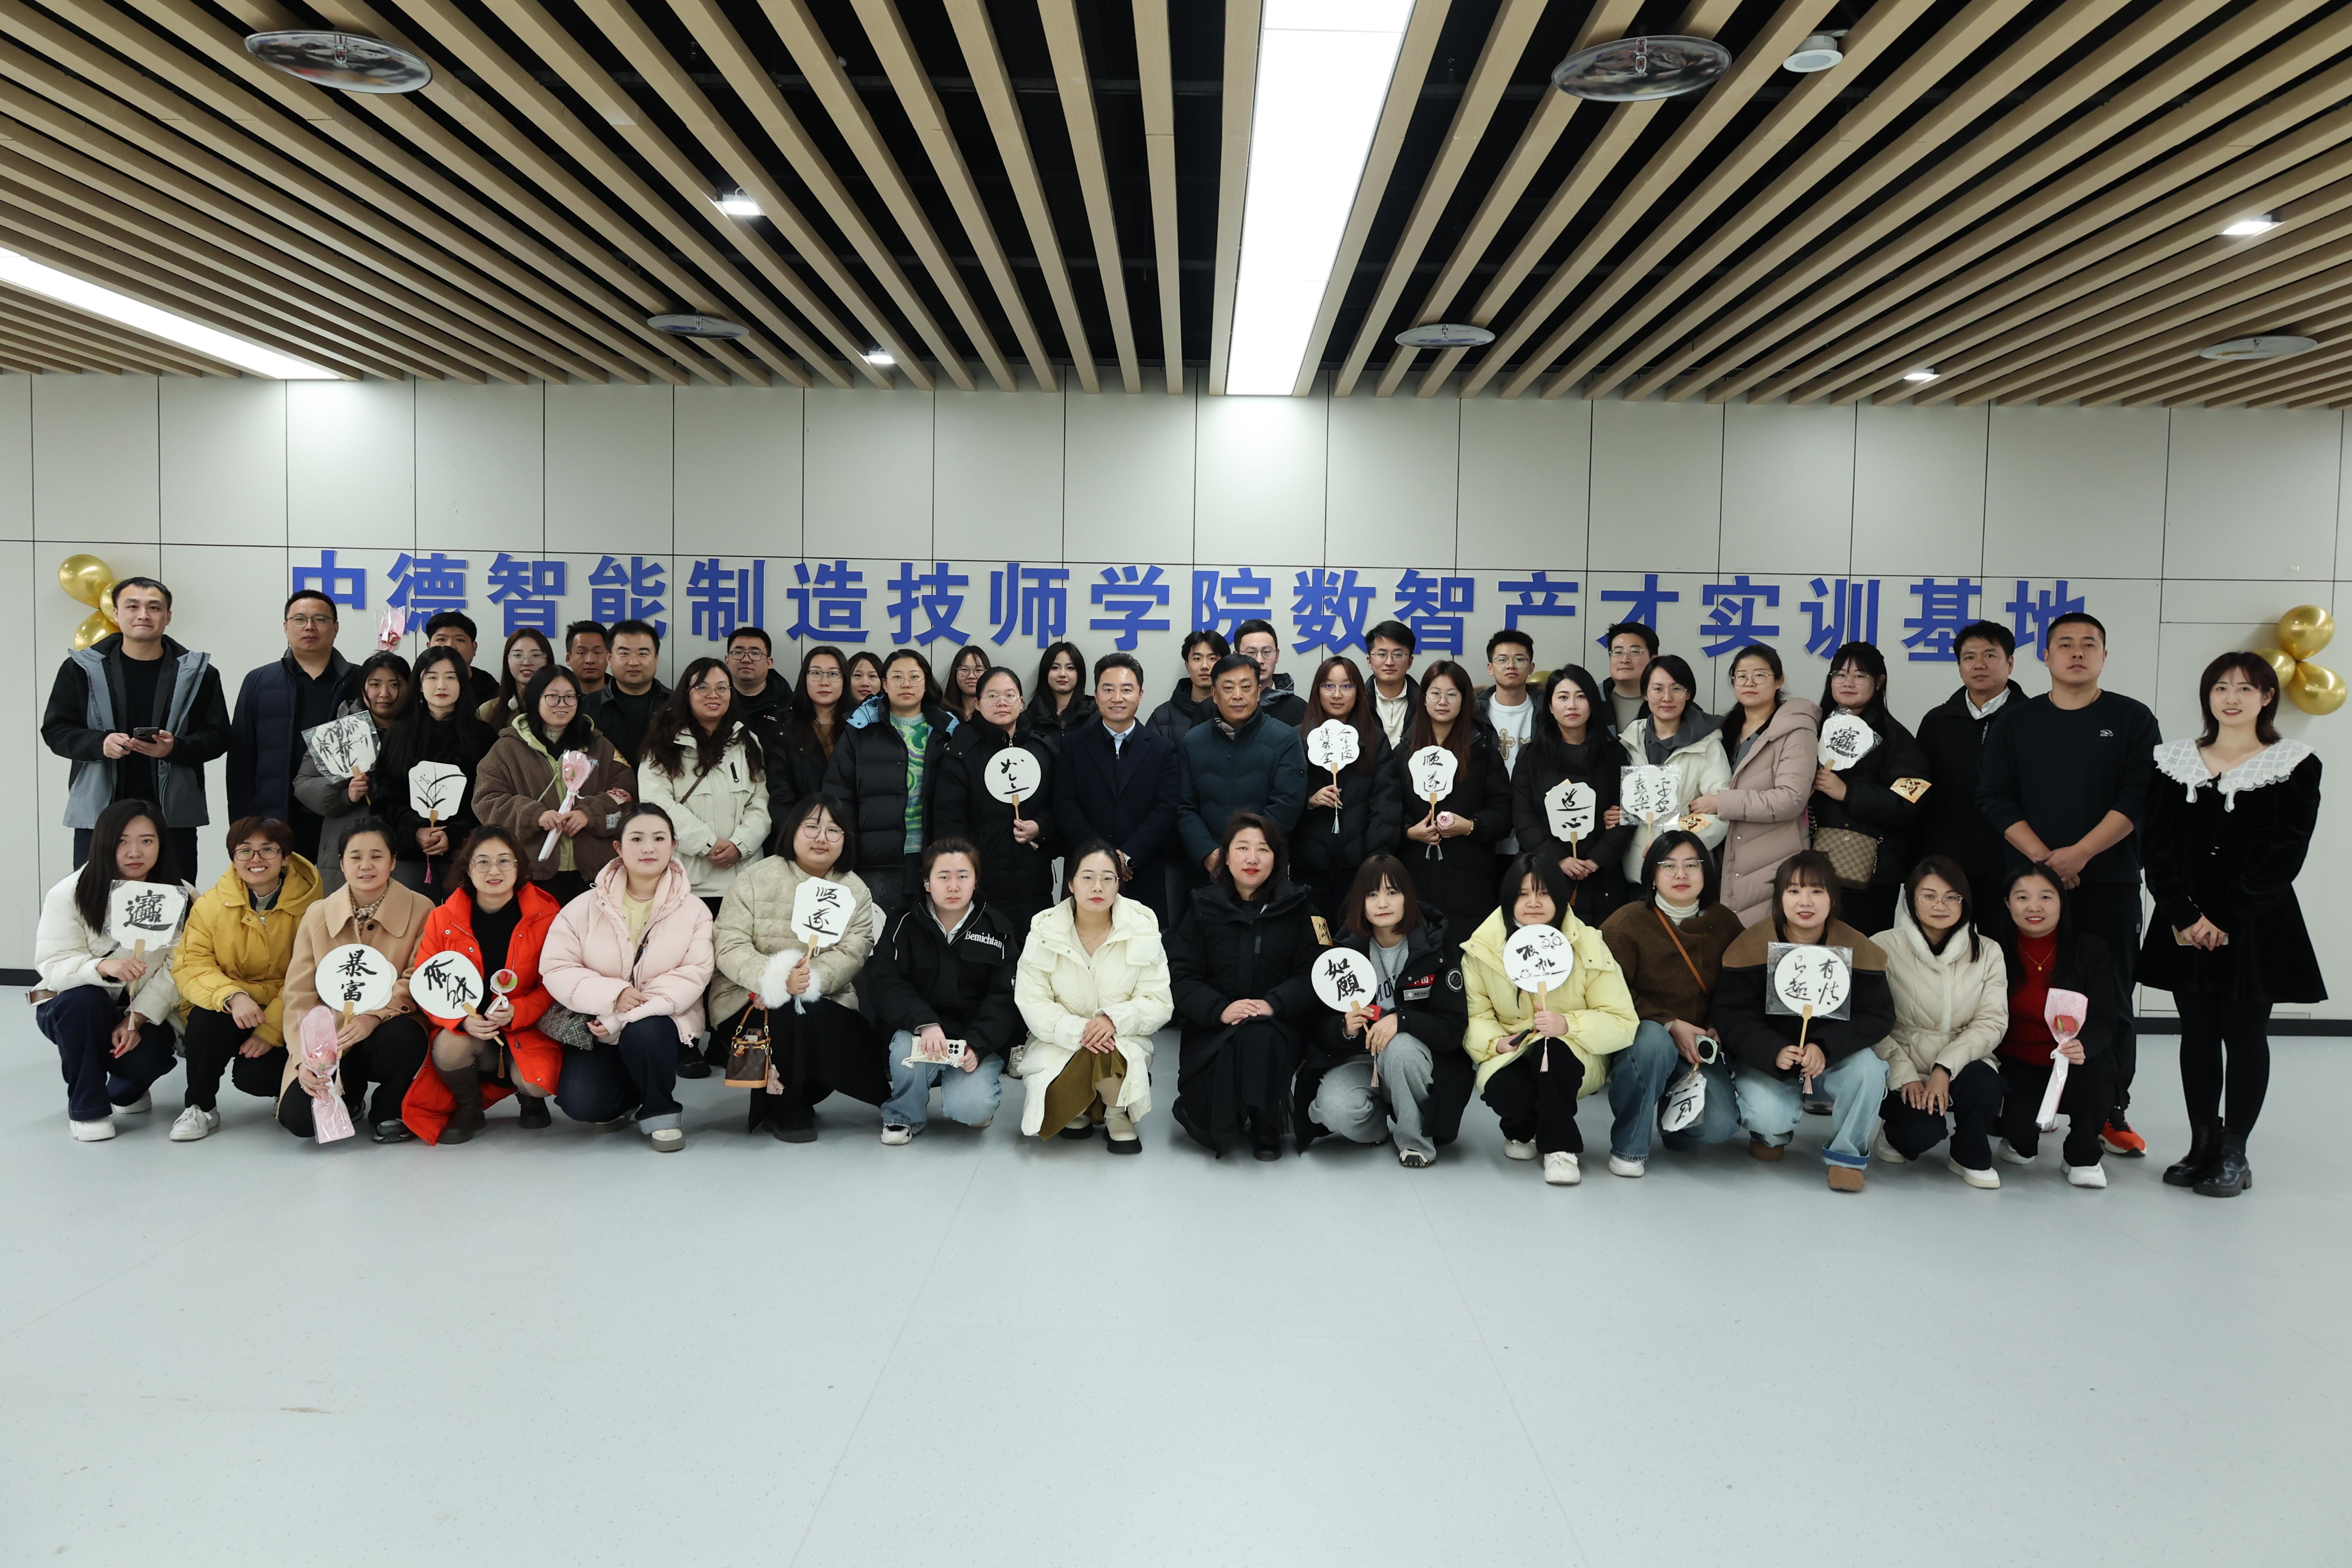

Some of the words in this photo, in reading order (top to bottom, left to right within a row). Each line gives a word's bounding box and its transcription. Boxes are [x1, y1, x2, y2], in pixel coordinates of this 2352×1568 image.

[293, 549, 2085, 662] 中德智能制造技师学院数智产才实训基地
[964, 931, 1002, 949] Bemichtan
[336, 949, 377, 1001] 暴富
